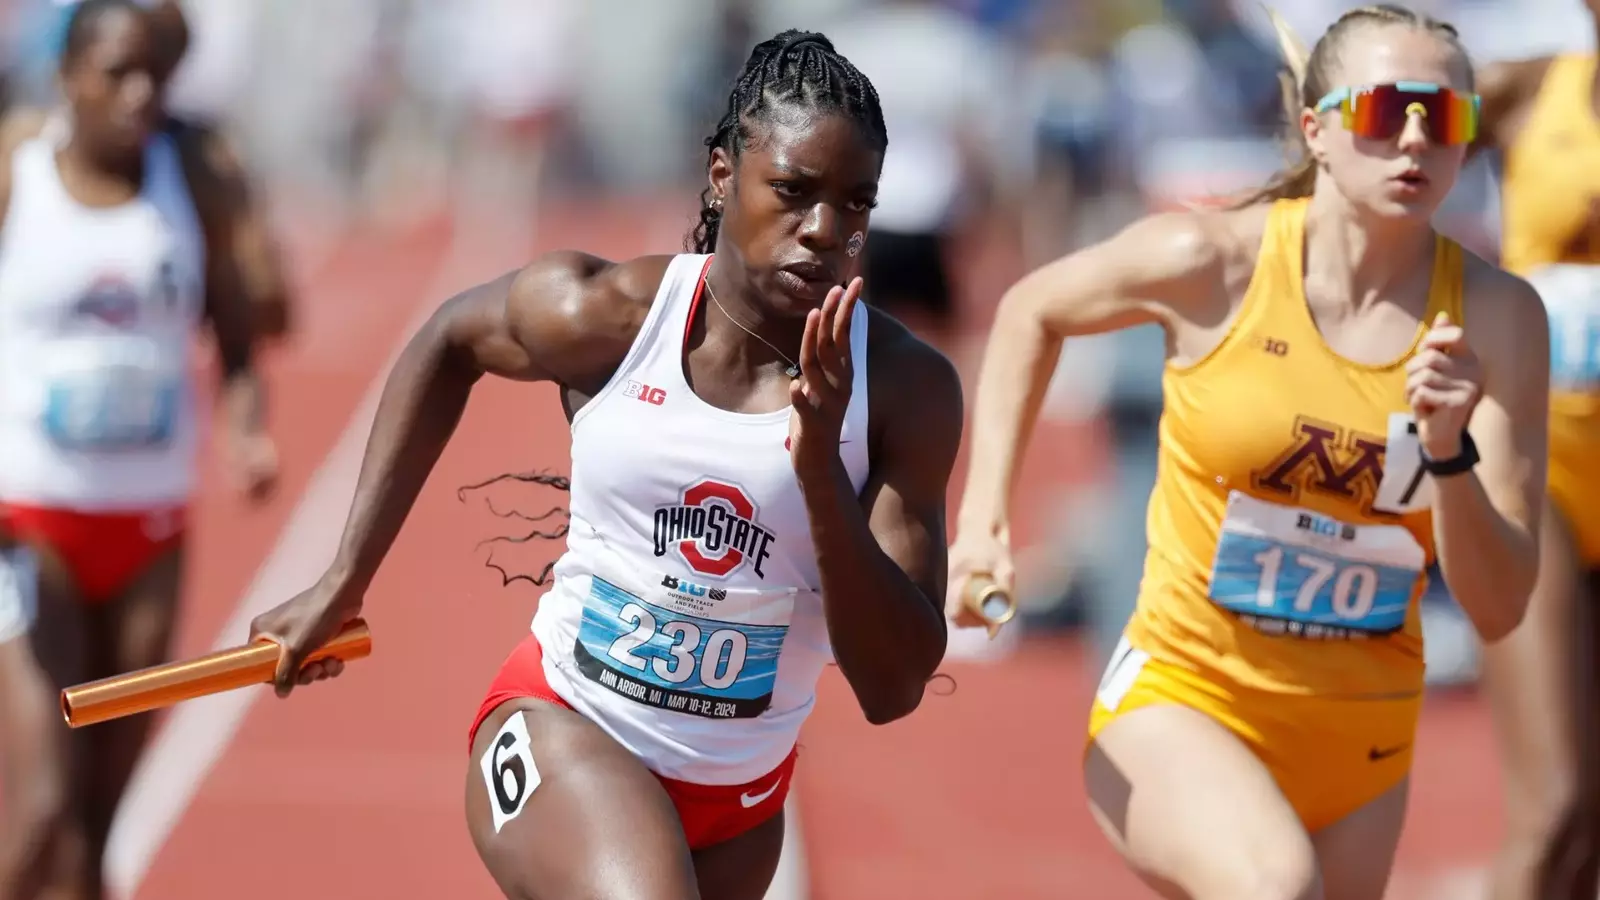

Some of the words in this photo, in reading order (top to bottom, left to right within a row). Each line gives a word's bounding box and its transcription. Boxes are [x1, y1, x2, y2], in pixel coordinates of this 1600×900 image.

[667, 592, 695, 603] OUTDOOR
[696, 599, 714, 607] TRACK
[687, 603, 704, 611] FIELD
[1255, 546, 1378, 621] 170
[606, 601, 749, 691] 230
[600, 669, 618, 688] ANN
[617, 678, 647, 701] ARBOR,
[649, 689, 662, 704] MI
[667, 694, 688, 709] MAY
[688, 698, 712, 715] 10-12,
[714, 703, 737, 717] 2024
[491, 731, 527, 815] 6
